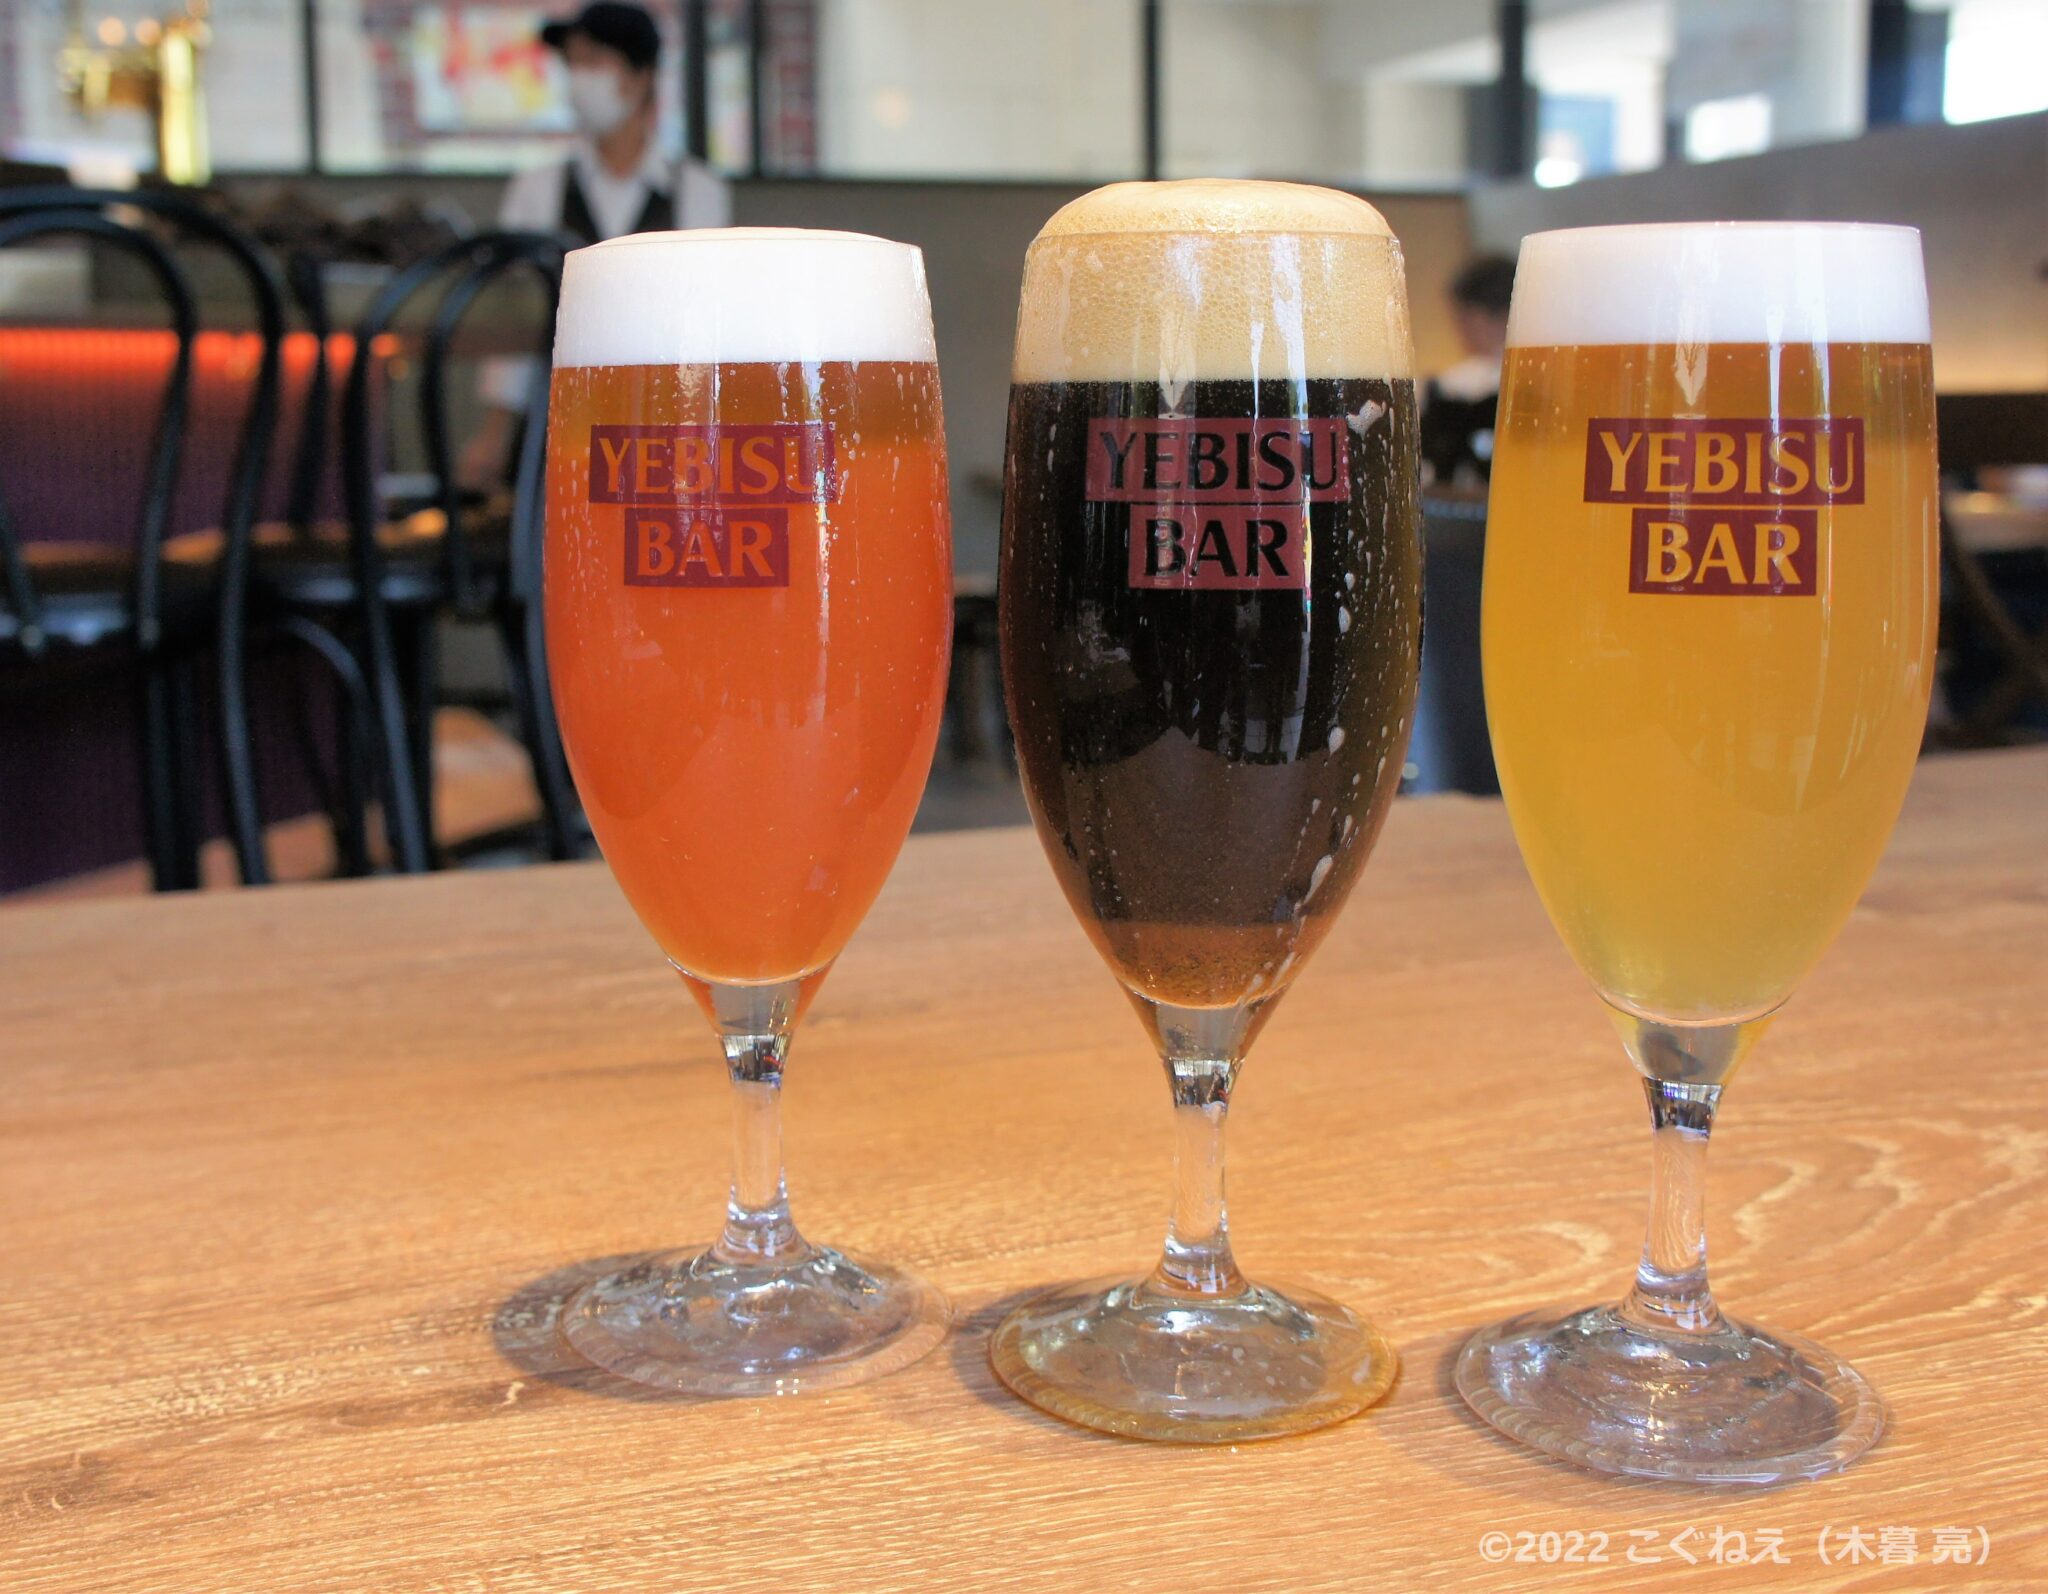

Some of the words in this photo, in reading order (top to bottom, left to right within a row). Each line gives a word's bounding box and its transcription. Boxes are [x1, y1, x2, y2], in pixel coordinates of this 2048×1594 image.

[599, 436, 828, 495] YEBISU
[1099, 431, 1338, 491] YEBISU
[1599, 431, 1855, 495] YEBISU
[636, 519, 776, 578] BAR
[1144, 518, 1290, 577] BAR
[1644, 521, 1802, 585] BAR
